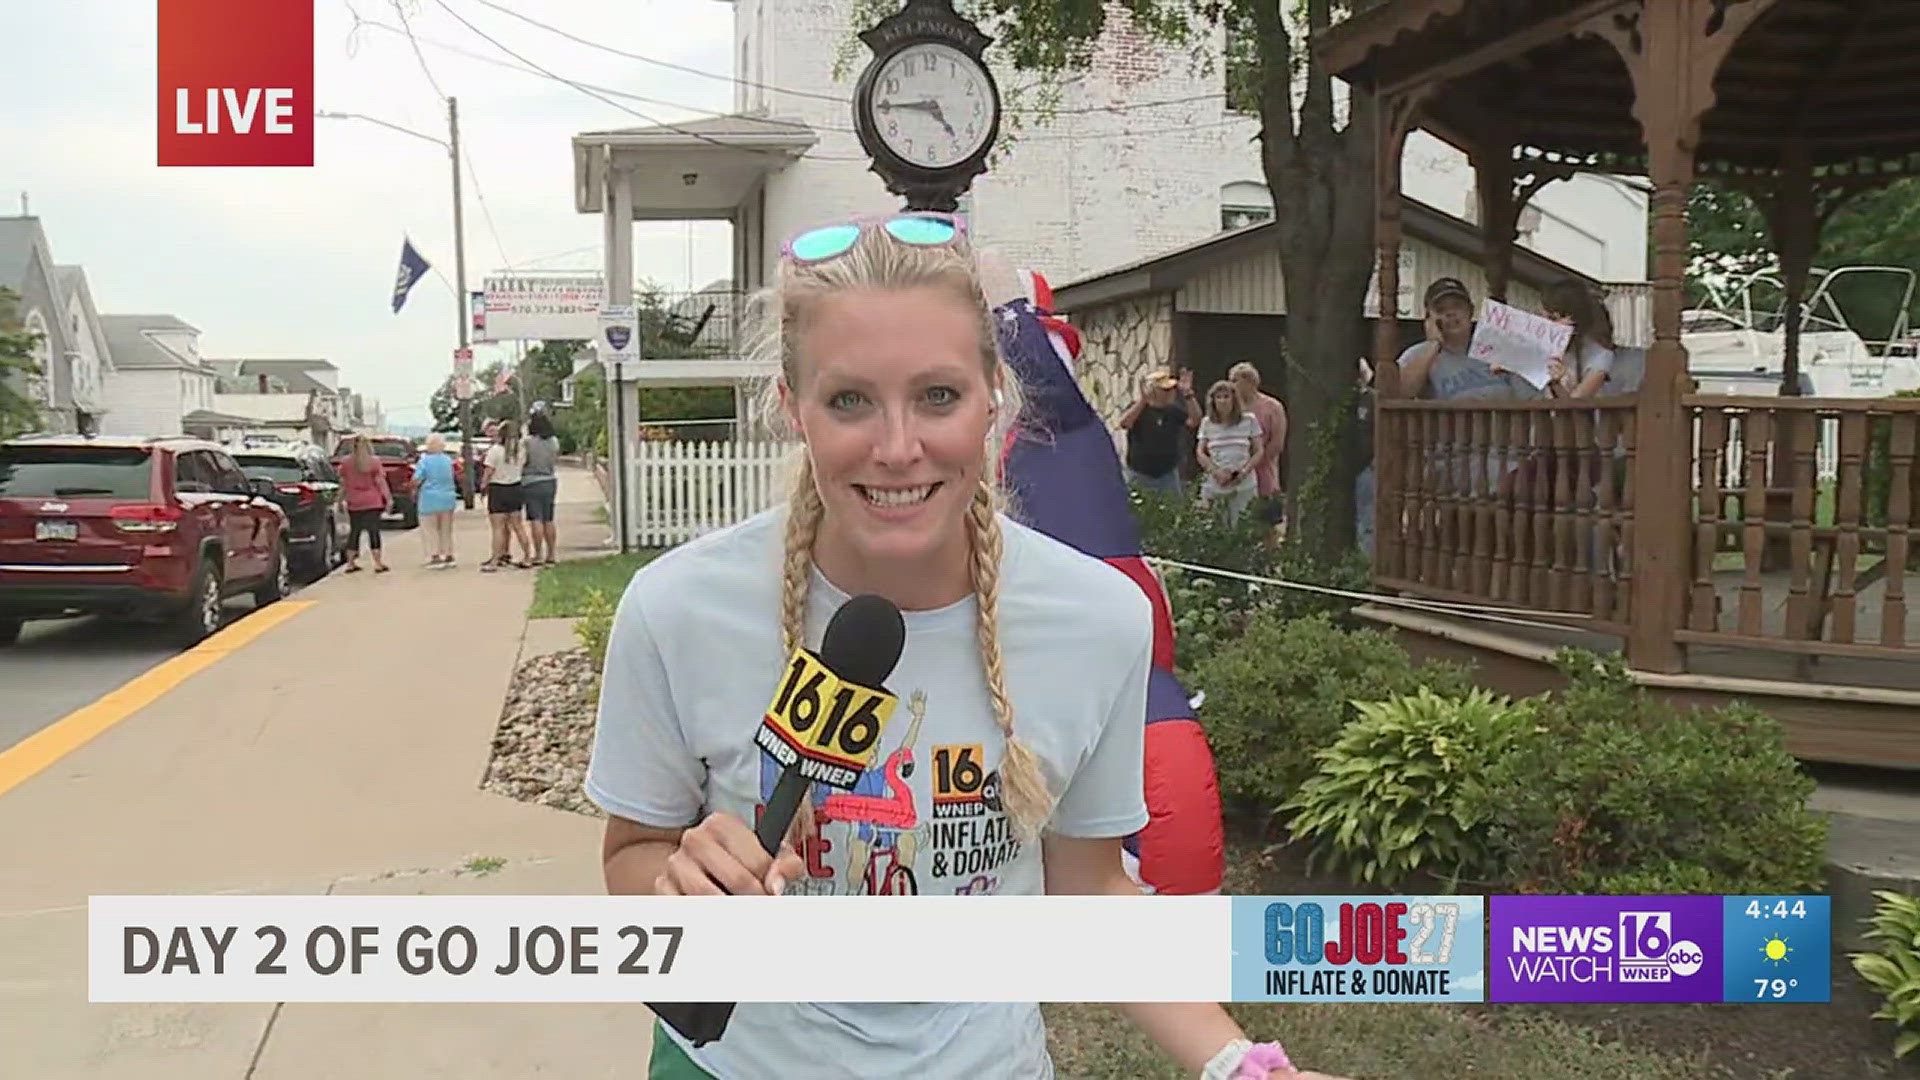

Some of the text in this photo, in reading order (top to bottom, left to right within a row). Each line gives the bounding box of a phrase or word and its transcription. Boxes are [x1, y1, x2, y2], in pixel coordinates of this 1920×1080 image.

[924, 53, 937, 71] 12
[886, 79, 900, 95] 10
[965, 82, 974, 96] 2
[888, 122, 898, 137] 8
[966, 122, 975, 139] 4
[903, 138, 914, 154] 7
[928, 146, 937, 160] 6
[774, 656, 827, 732] 16
[817, 689, 885, 754] 16
[756, 725, 798, 767] WNEP
[800, 759, 857, 786] WNEP
[934, 748, 983, 793] 16
[935, 803, 983, 817] WNEP
[932, 852, 948, 878] &
